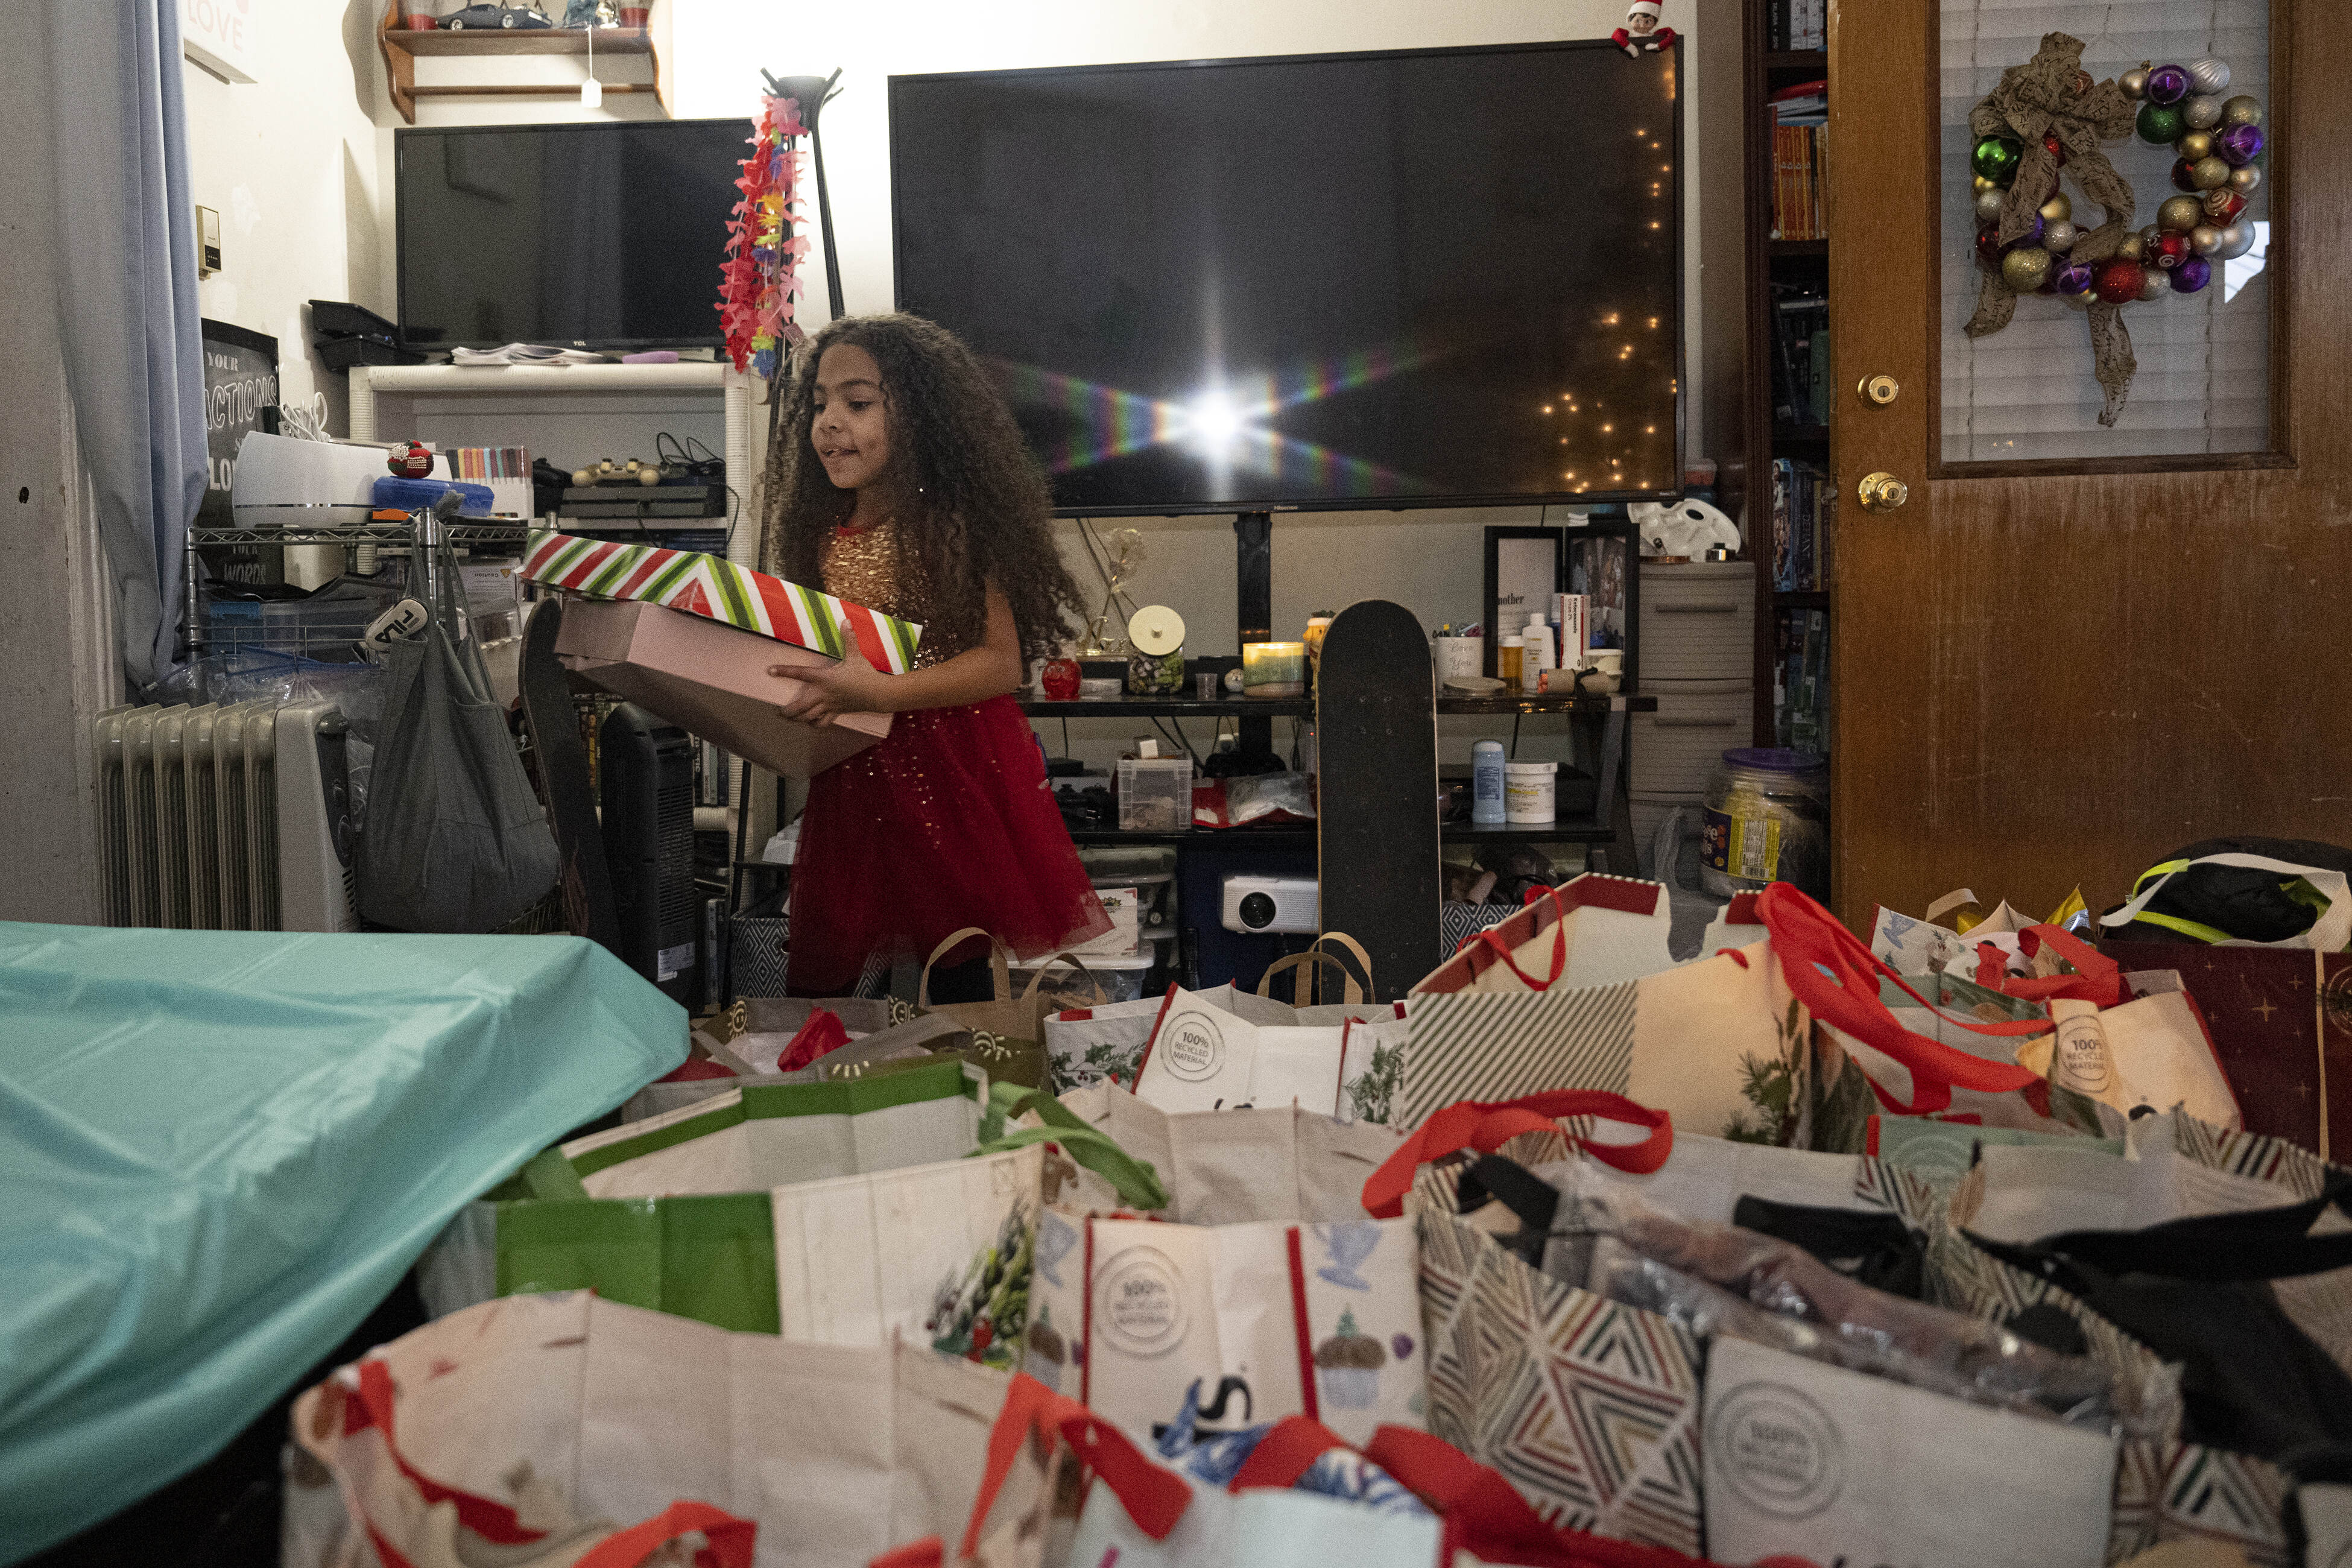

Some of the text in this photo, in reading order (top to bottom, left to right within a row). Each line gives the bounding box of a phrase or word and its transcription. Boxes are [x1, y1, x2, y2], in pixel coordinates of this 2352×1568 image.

[188, 0, 244, 53] LOVE
[207, 352, 239, 372] YOUR
[224, 563, 267, 584] WORDS
[375, 609, 420, 643] FILA
[1175, 1042, 1209, 1057] RECYCLED
[1183, 1031, 1209, 1048] 100%
[1173, 1051, 1207, 1065] MATERIAL
